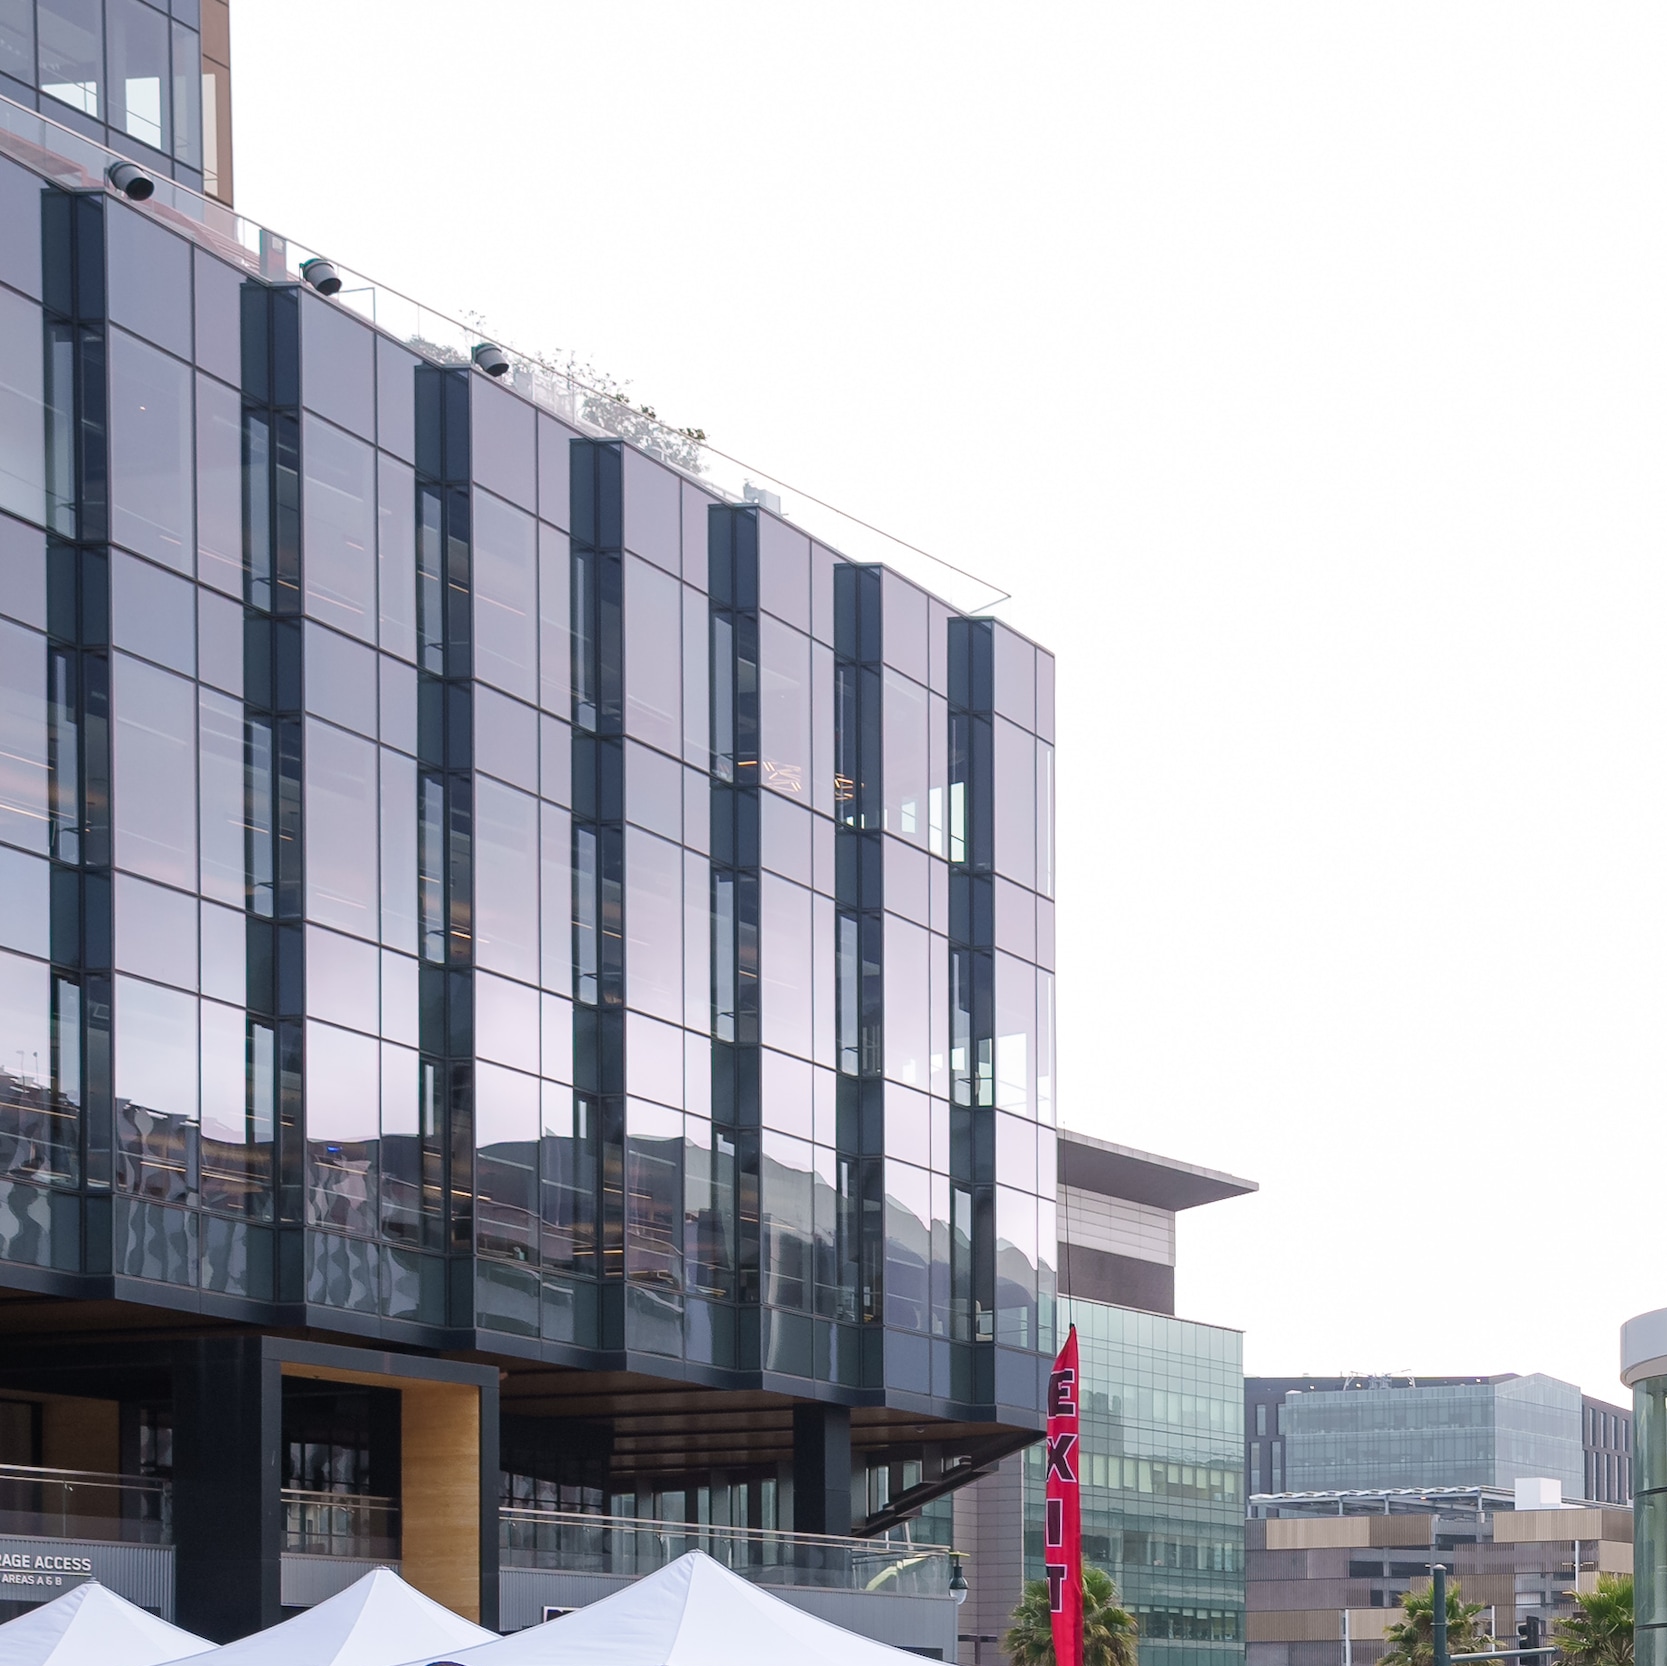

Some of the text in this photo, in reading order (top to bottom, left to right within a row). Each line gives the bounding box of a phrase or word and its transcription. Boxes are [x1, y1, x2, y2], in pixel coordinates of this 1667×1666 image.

[1046, 1367, 1078, 1614] EXIT
[0, 1554, 92, 1571] AGE ACCESS
[2, 1574, 35, 1585] AREAS
[37, 1576, 45, 1586] A
[55, 1577, 62, 1586] B
